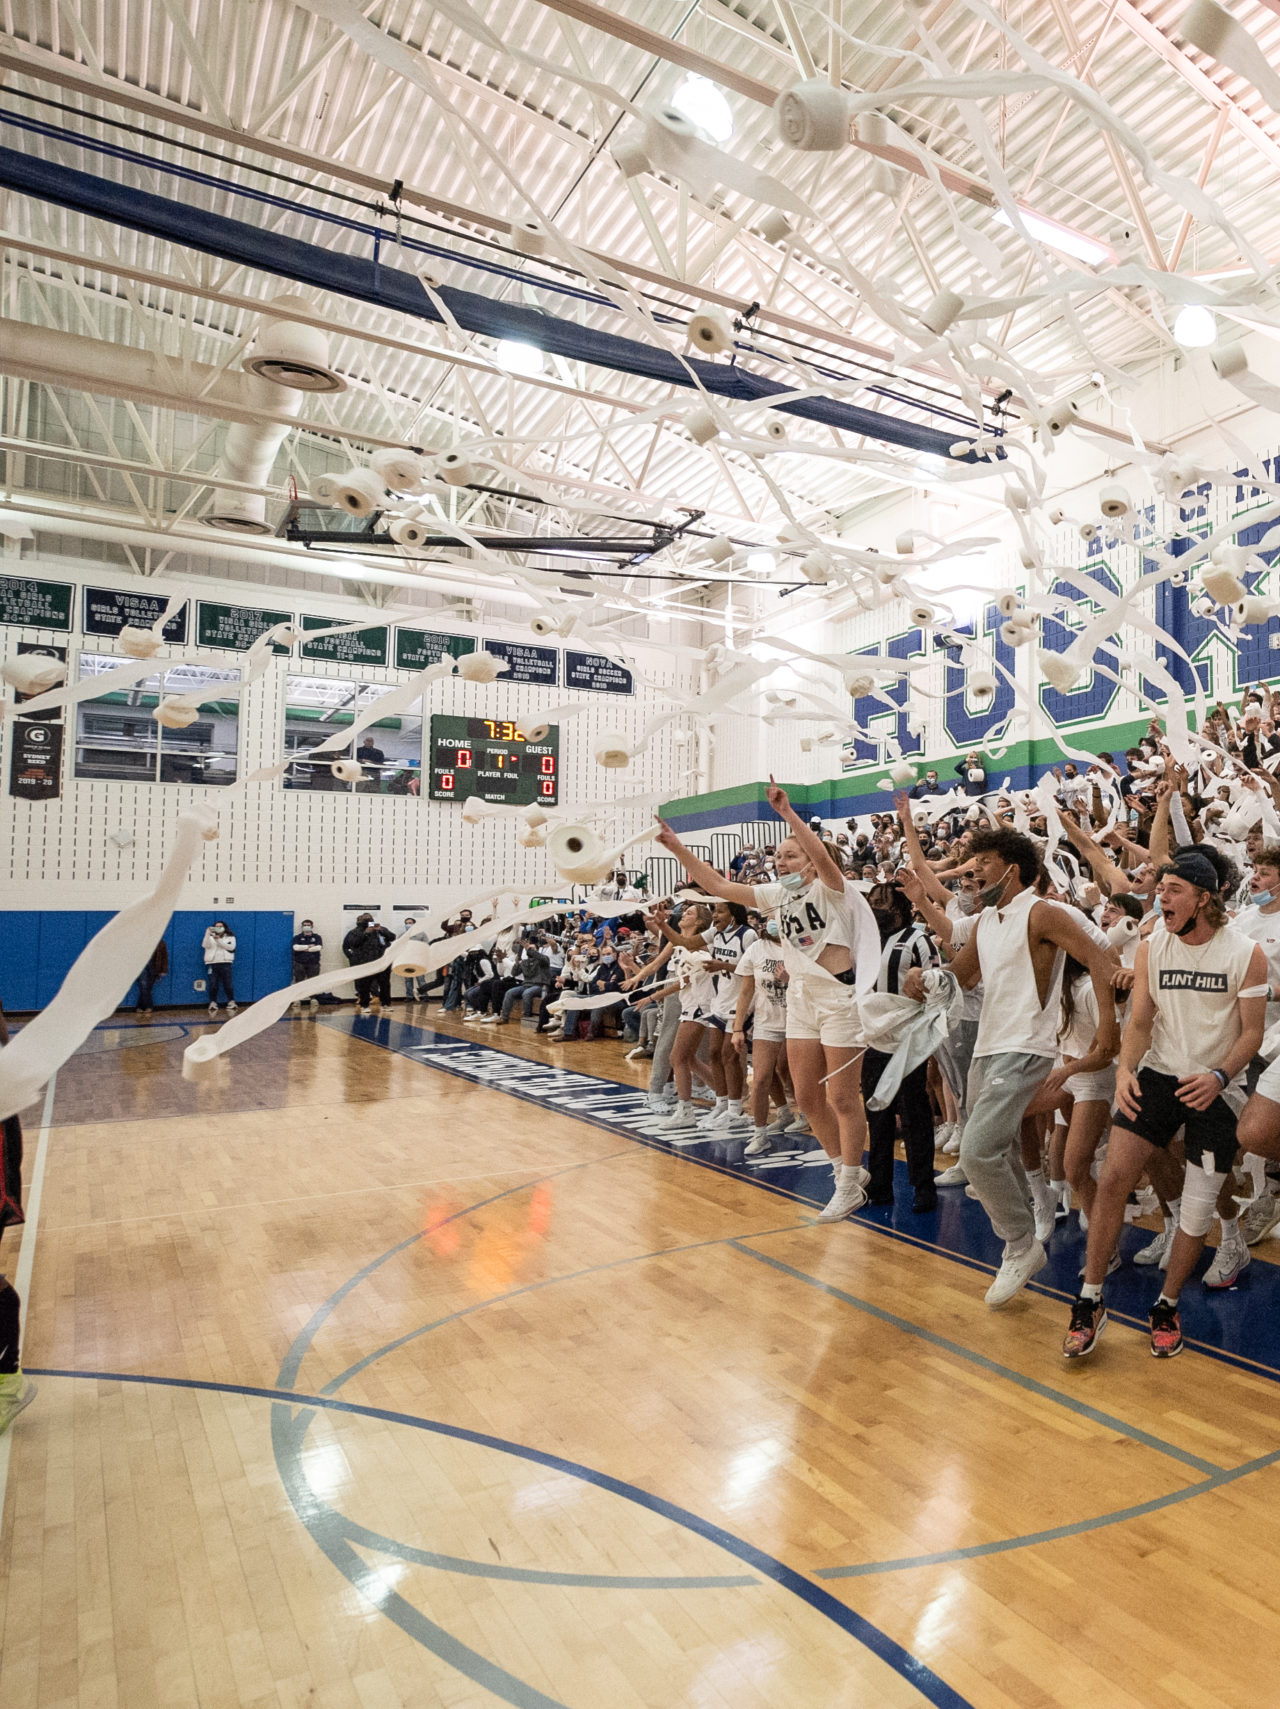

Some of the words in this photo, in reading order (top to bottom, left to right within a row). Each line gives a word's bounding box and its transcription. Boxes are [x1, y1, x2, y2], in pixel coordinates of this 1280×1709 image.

[115, 595, 158, 610] VISAA
[231, 608, 263, 621] 2017
[505, 645, 538, 658] VISAA
[585, 656, 613, 668] NOVA
[30, 730, 45, 742] G
[437, 738, 472, 749] HOME
[525, 745, 554, 755] GUEST
[541, 756, 555, 774] 0
[477, 770, 501, 778] PLAYER
[537, 774, 556, 782] FOULS
[441, 774, 454, 790] 0
[542, 781, 554, 795] 0
[434, 790, 455, 798] SCORE
[484, 793, 506, 801] MATCH
[1195, 974, 1226, 990] HILL
